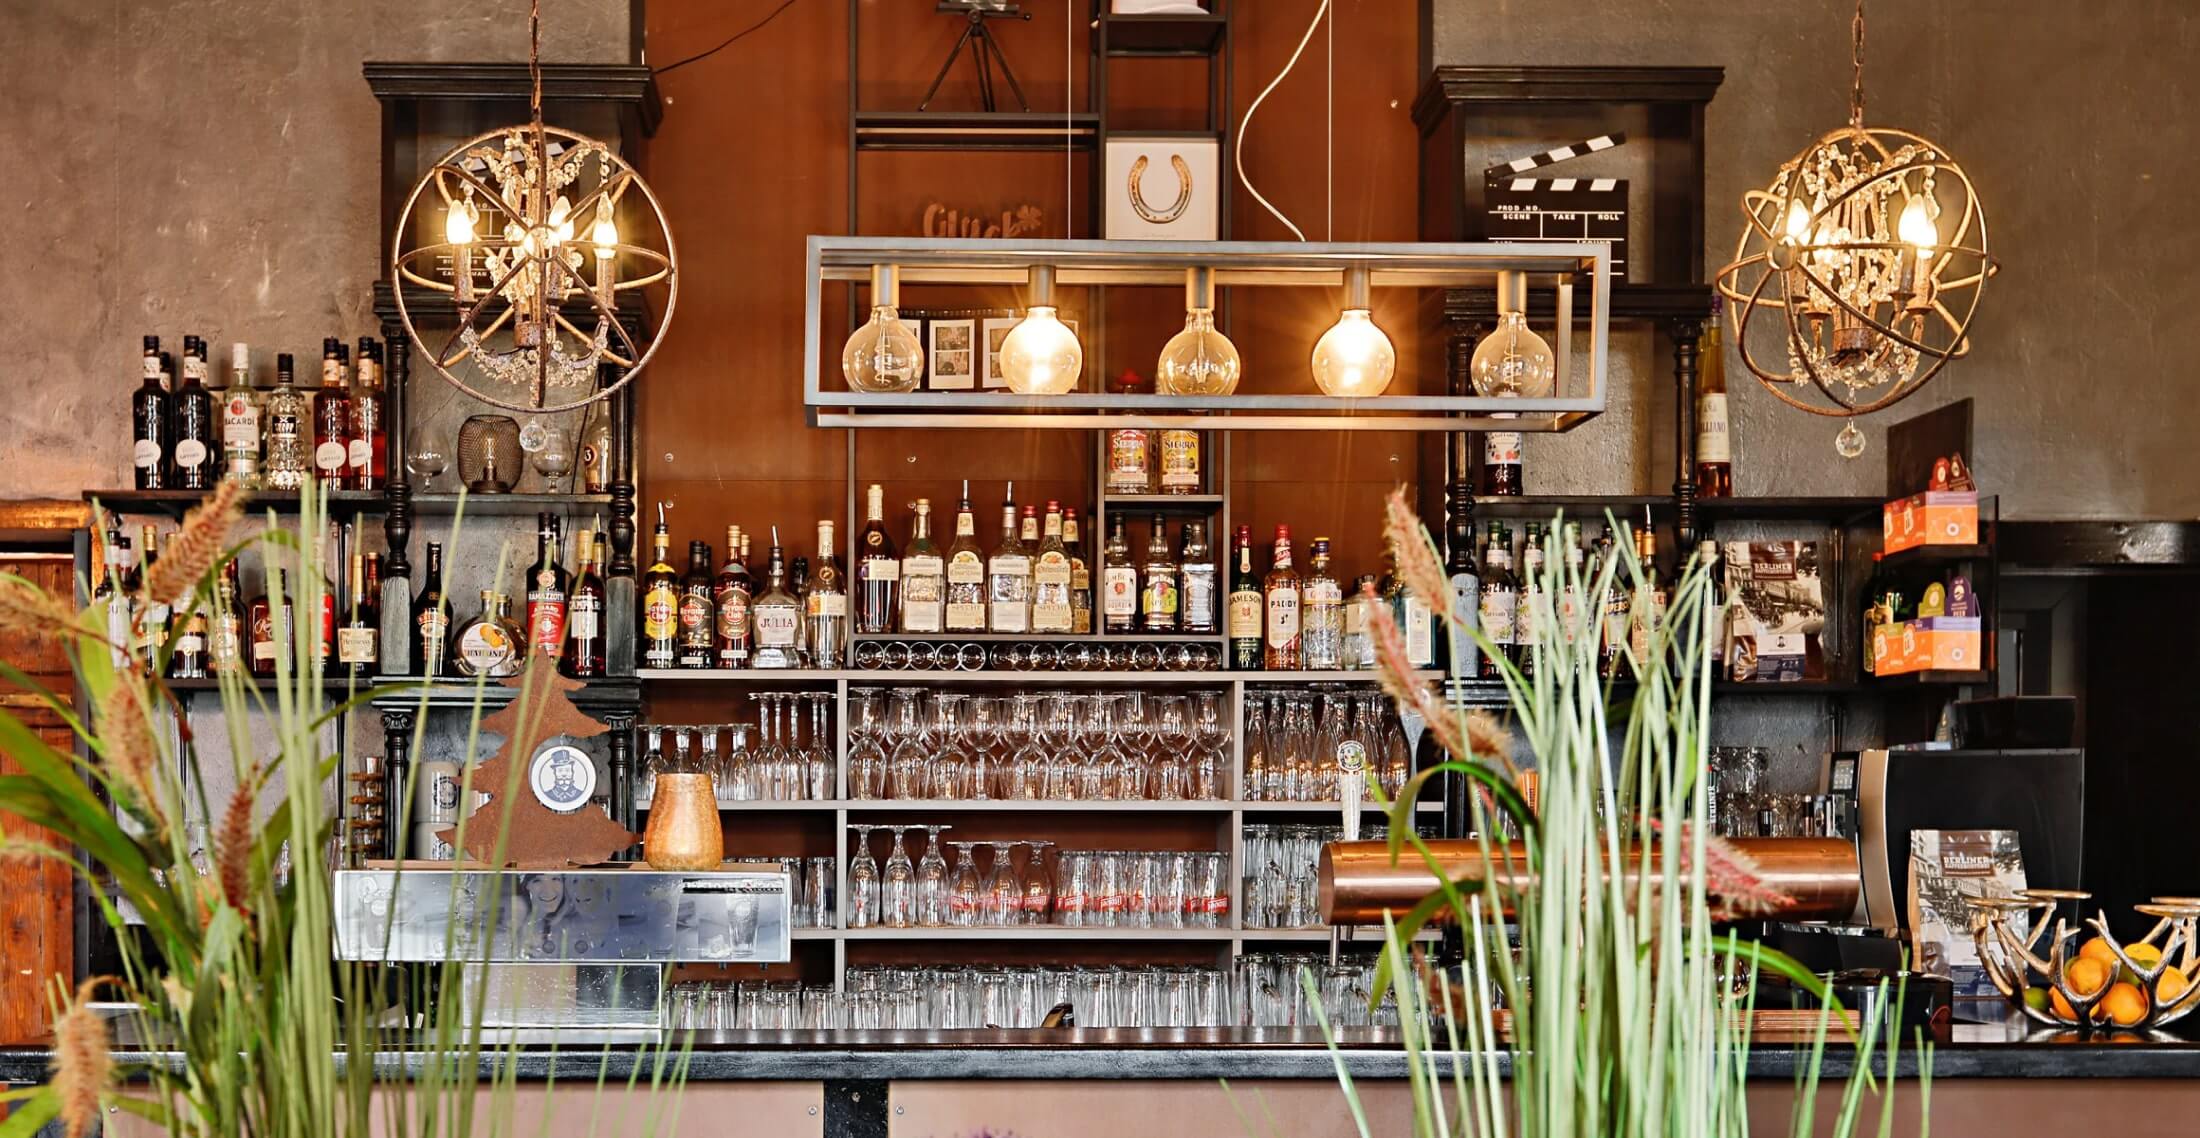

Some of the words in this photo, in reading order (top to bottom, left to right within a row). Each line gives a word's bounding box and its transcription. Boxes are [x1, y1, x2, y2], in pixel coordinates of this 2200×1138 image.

[1113, 439, 1144, 448] SIERRA
[1164, 440, 1196, 448] SIERRA
[1943, 855, 1988, 864] BERLINER
